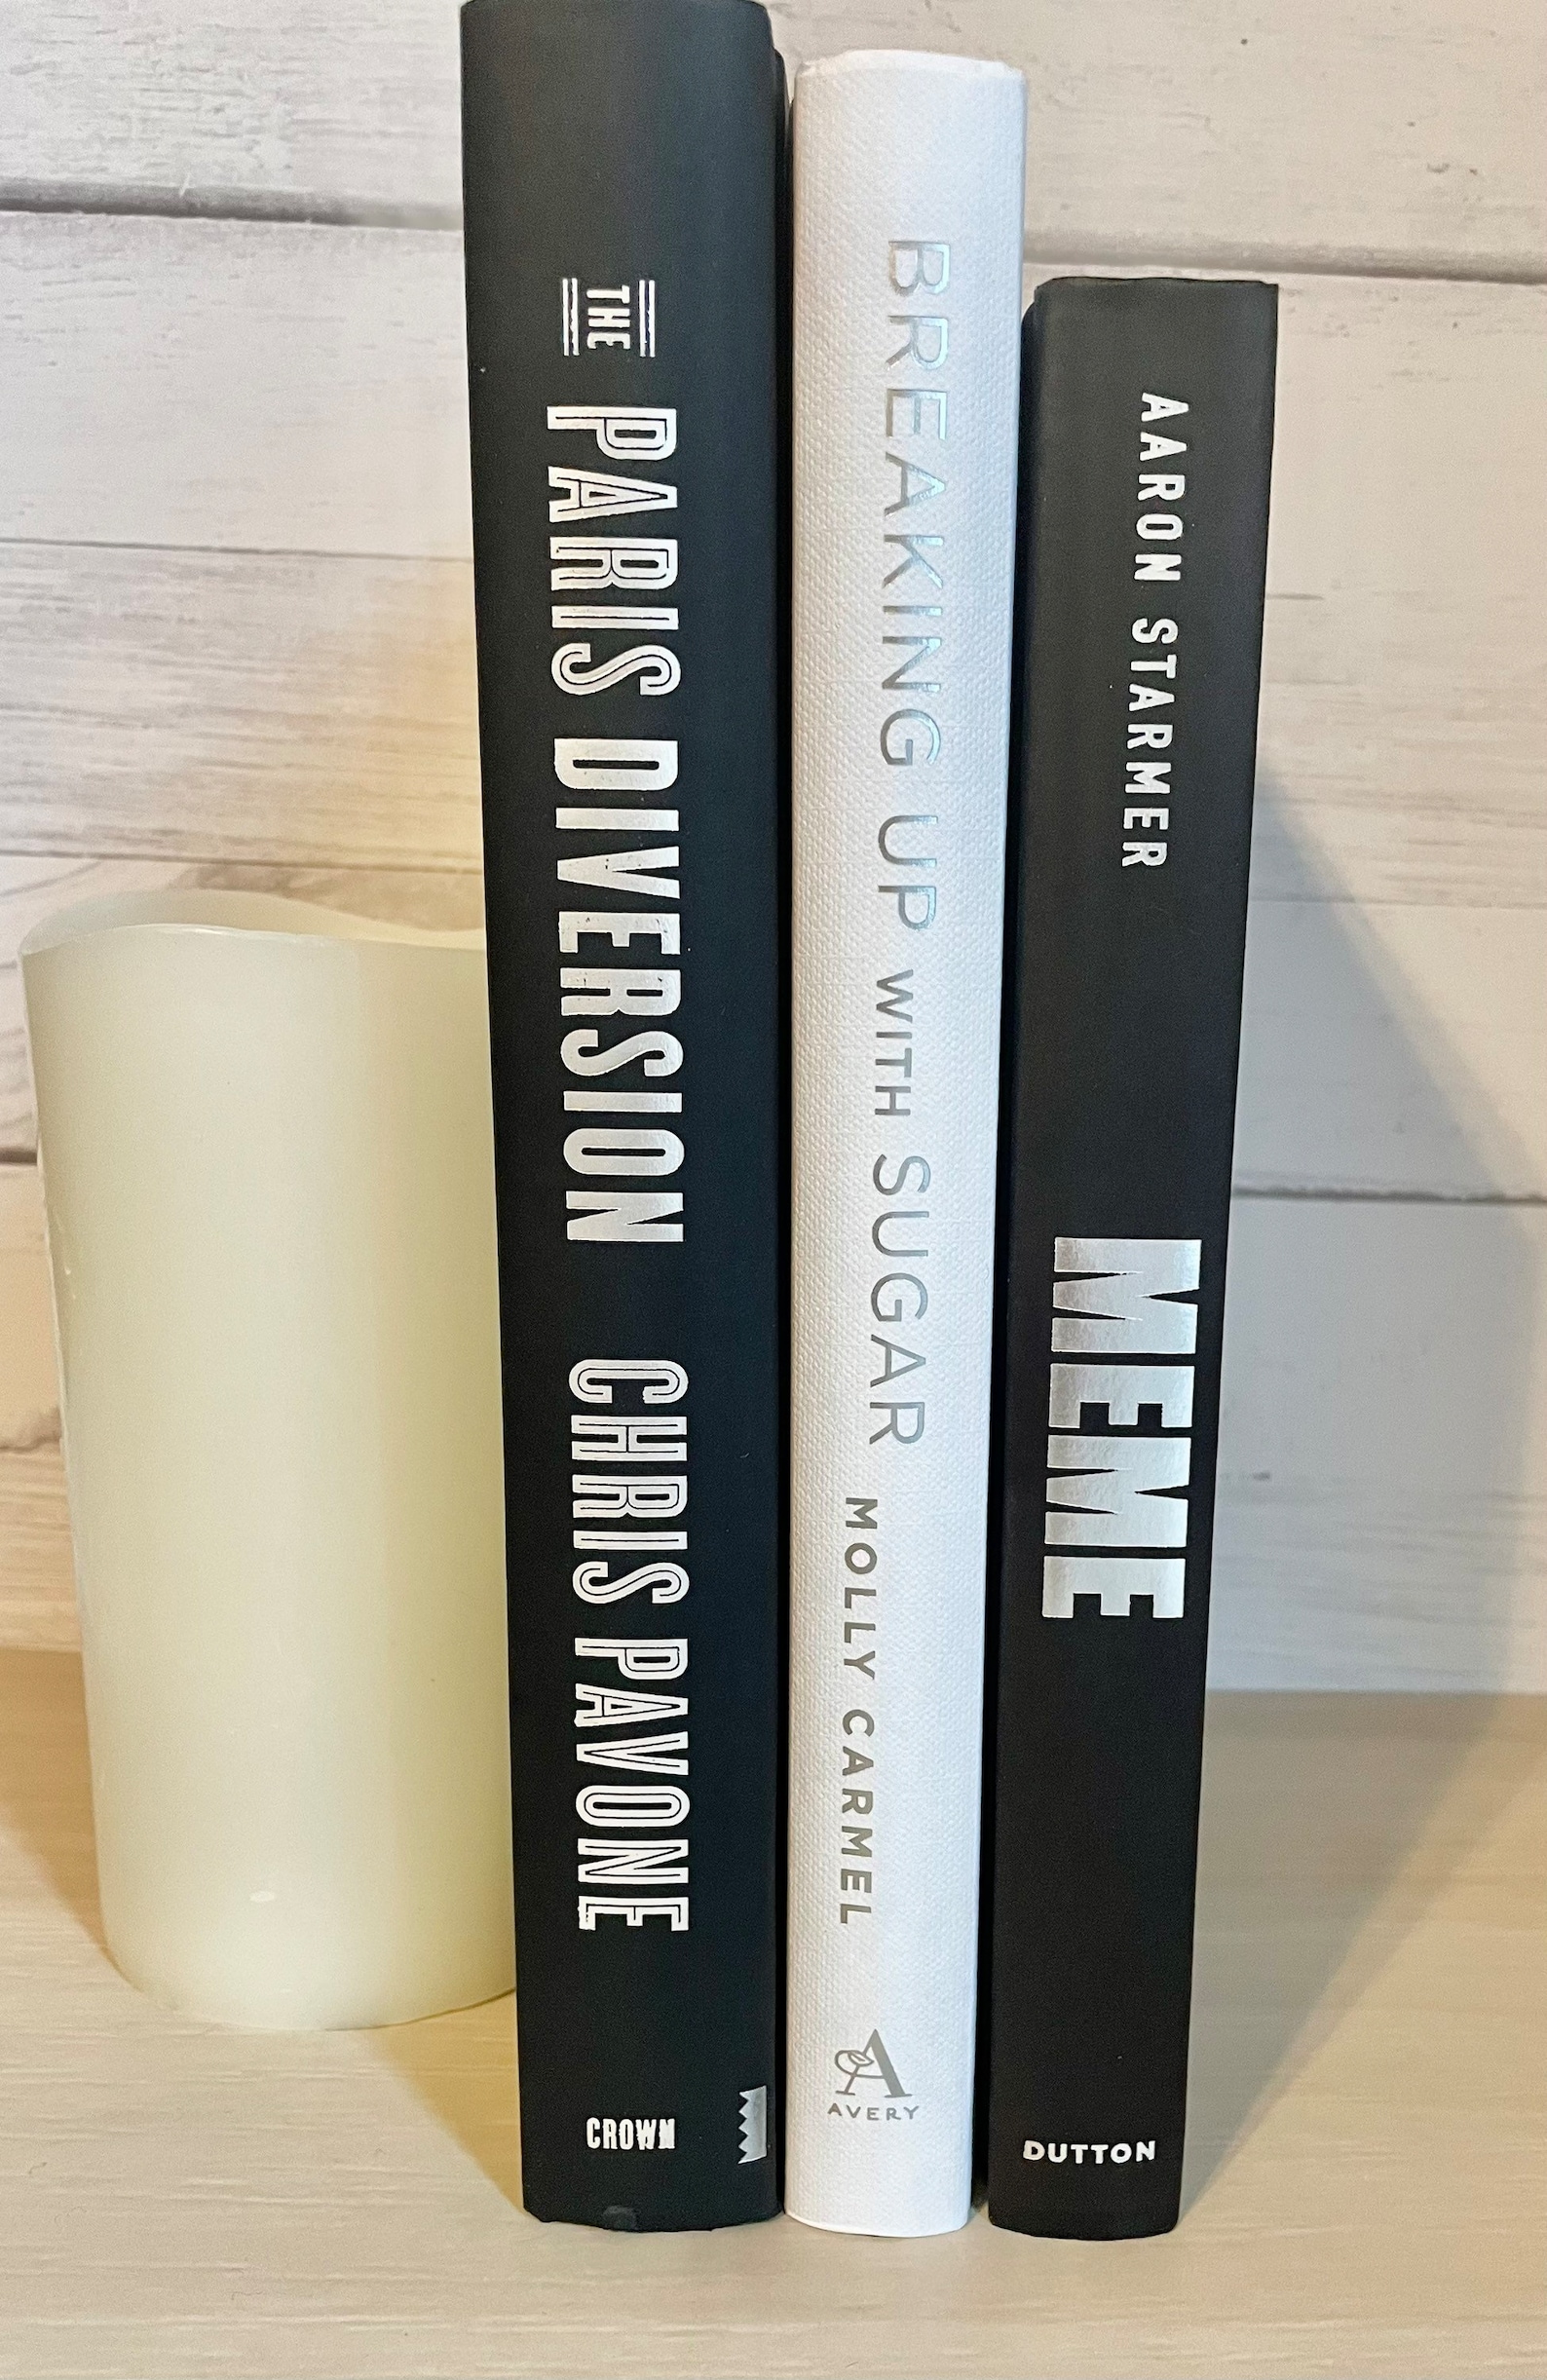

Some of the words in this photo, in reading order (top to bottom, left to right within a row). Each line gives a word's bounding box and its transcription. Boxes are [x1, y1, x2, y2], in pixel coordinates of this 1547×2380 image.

[586, 284, 631, 352] THE
[547, 405, 682, 696] PARIS
[880, 239, 952, 766] BREAKING
[1133, 392, 1189, 582] AARON
[1121, 617, 1179, 868] STARMER
[878, 814, 939, 931] UP
[553, 737, 685, 1243] DIVERSION
[874, 968, 914, 1117] WITH
[869, 1153, 930, 1446] SUGAR
[568, 1358, 690, 1605] CHRIS
[1041, 1237, 1203, 1619] MEME
[844, 1496, 879, 1681] MOLLY
[573, 1637, 691, 1932] PAVONE
[839, 1709, 875, 1925] CARMEL
[585, 2117, 675, 2151] CROWN
[827, 2100, 921, 2122] AVERY
[1022, 2139, 1156, 2165] DUTTON
